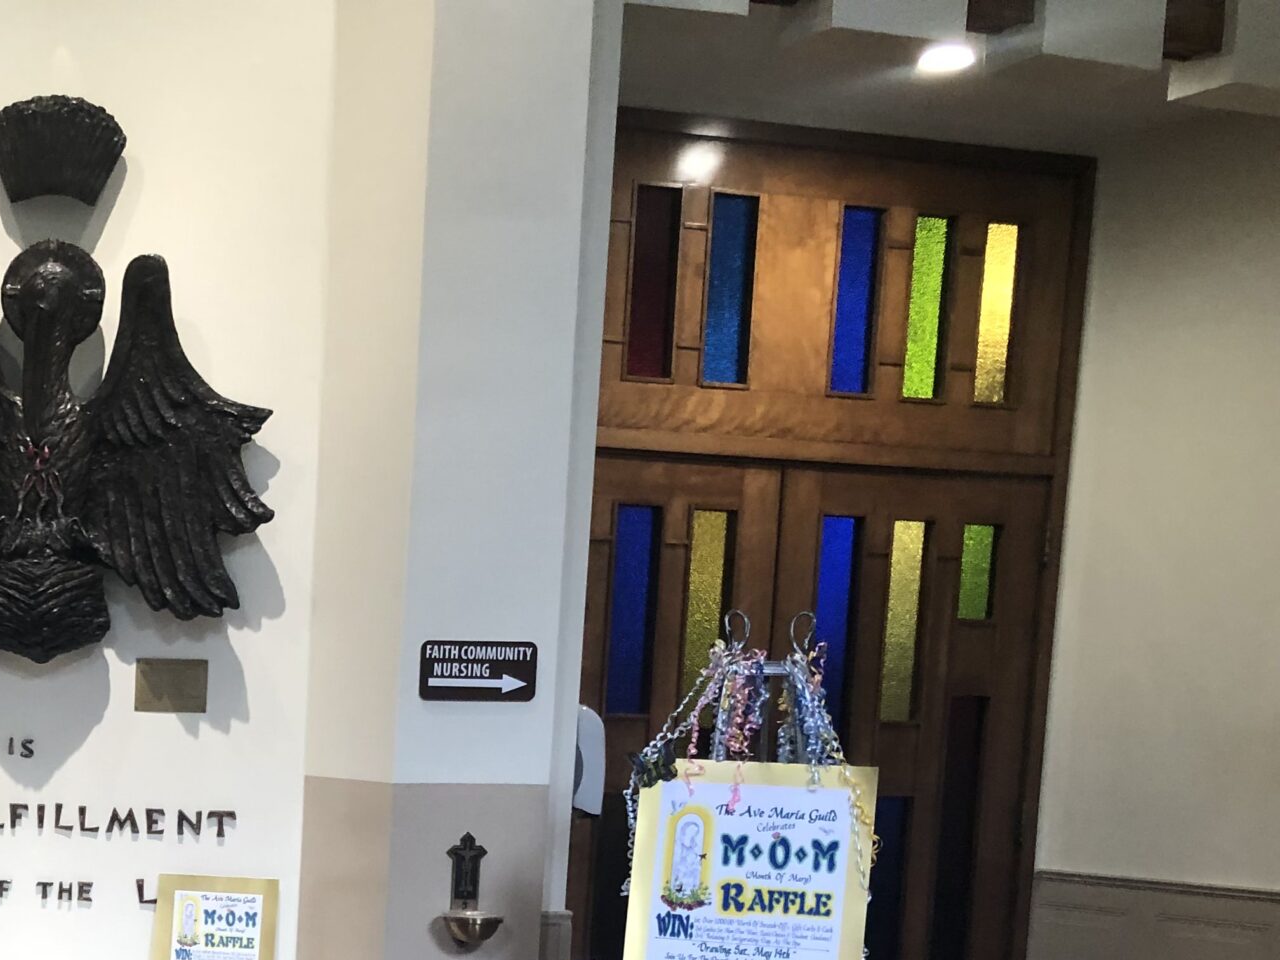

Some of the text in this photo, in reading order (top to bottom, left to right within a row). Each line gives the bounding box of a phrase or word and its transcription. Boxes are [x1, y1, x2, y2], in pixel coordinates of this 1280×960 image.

[425, 645, 533, 661] FAITH COMMUNITY
[433, 662, 490, 677] NURSING
[7, 737, 35, 758] IS
[739, 805, 765, 818] Ave
[768, 807, 805, 820] Maria
[808, 809, 838, 824] Guild
[756, 821, 796, 833] Celebrates
[35, 881, 94, 902] THE
[720, 882, 832, 917] RAFFLE
[656, 910, 694, 940] WIN:
[204, 933, 255, 949] RAFFLE
